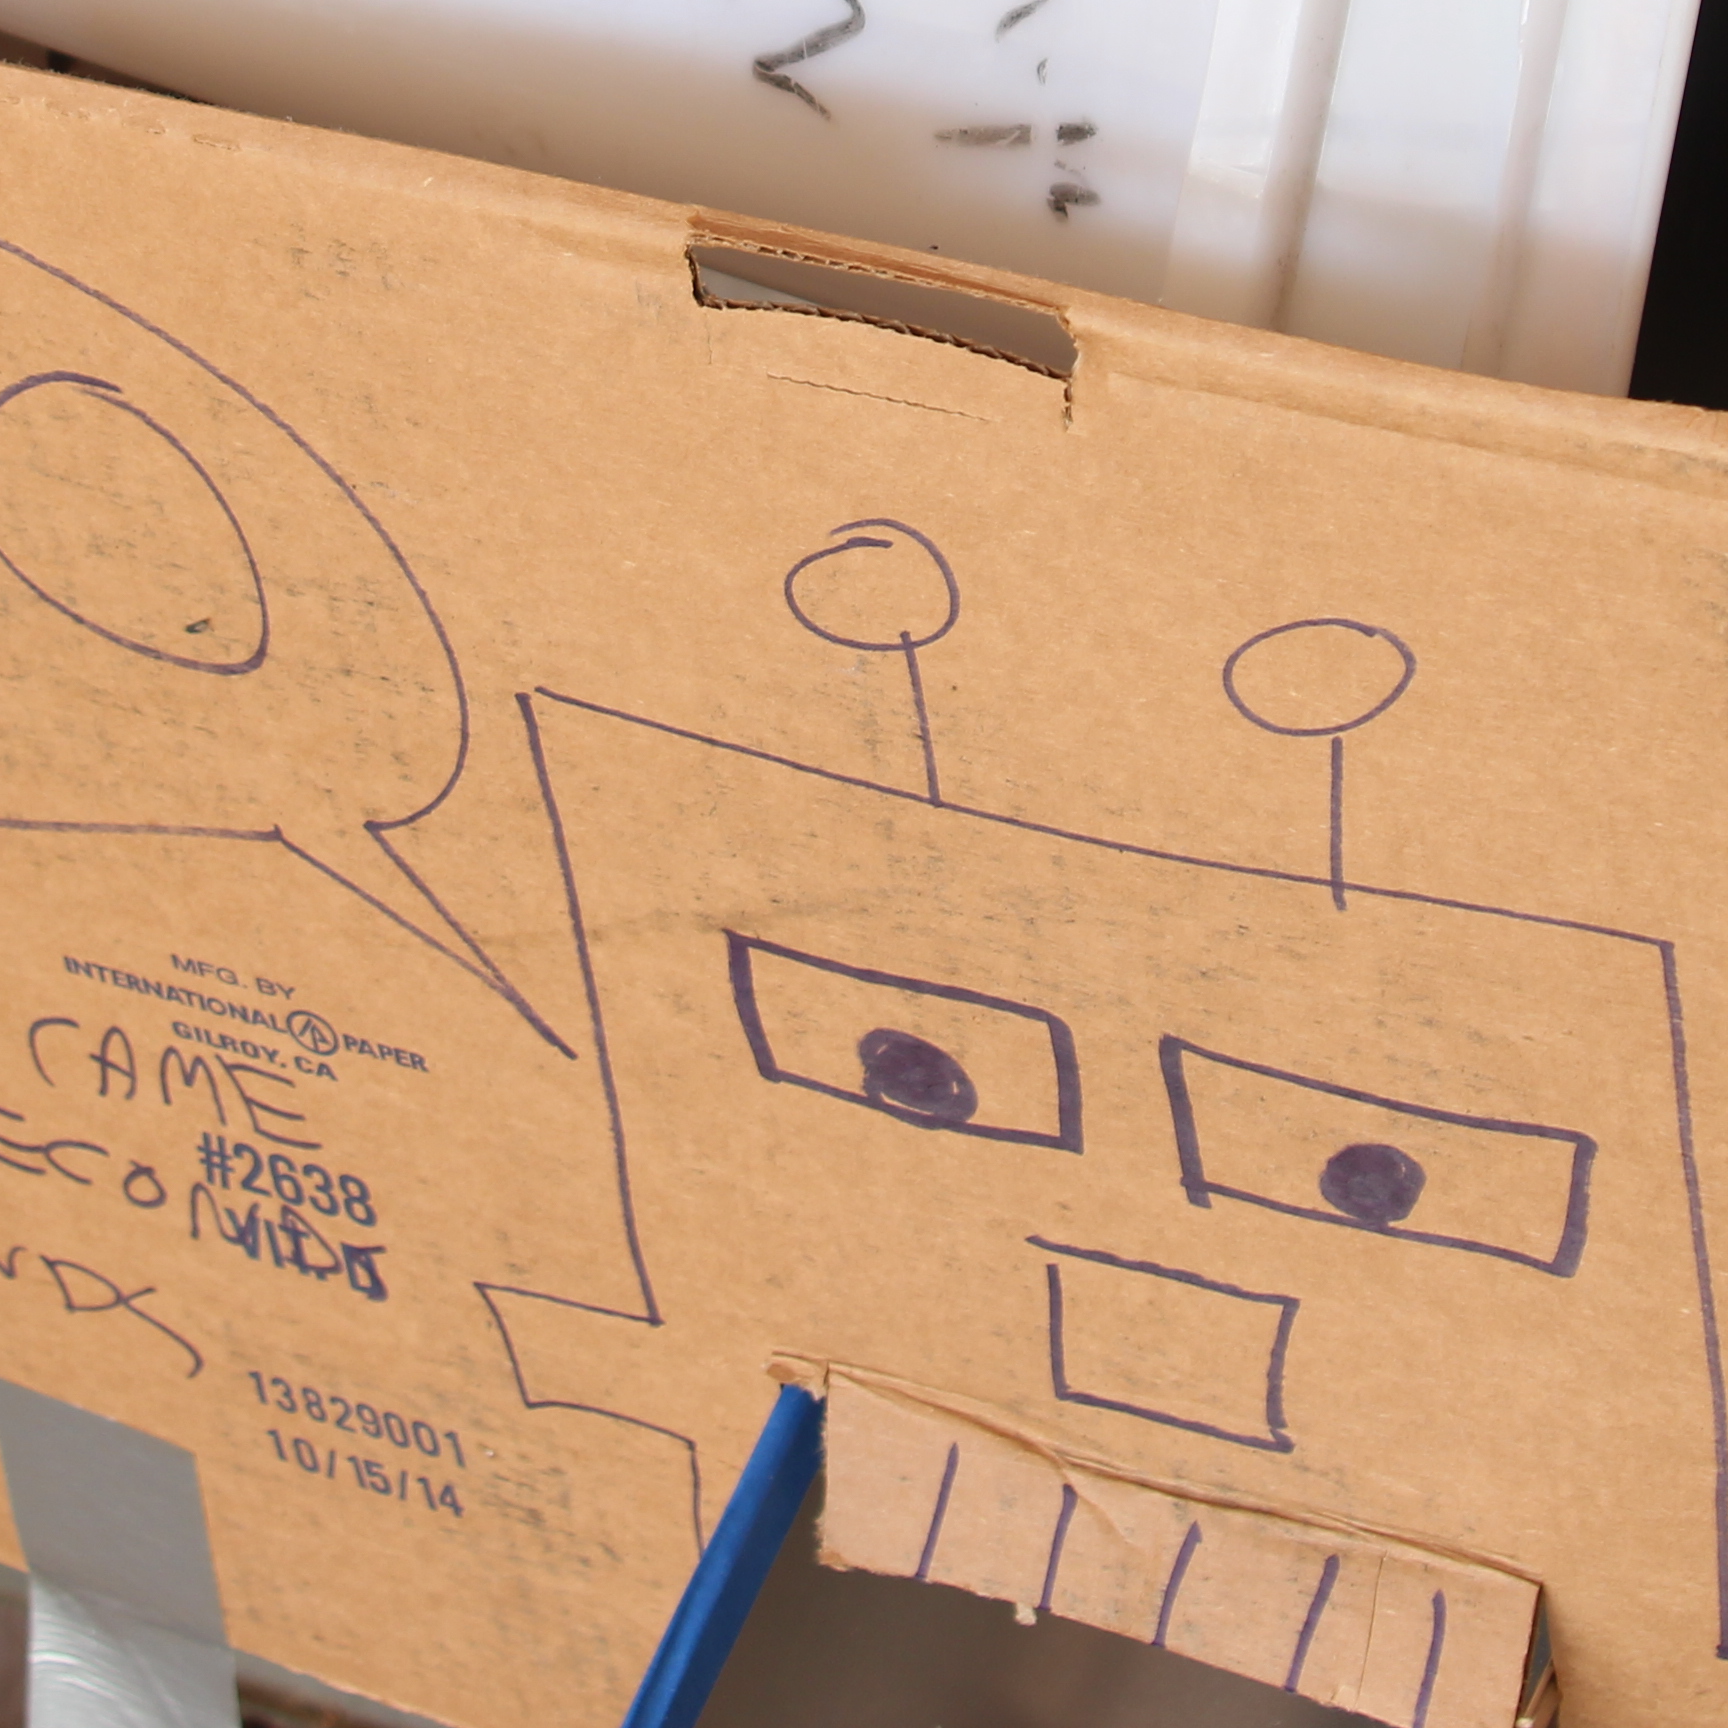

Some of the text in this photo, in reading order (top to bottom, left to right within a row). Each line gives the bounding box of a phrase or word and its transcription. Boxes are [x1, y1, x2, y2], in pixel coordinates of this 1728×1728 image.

[63, 954, 431, 1074] INTERNATIONAL PAPER
[170, 953, 297, 1001] MFG. BY
[28, 1016, 322, 1150] CAME
[294, 1055, 339, 1082] CA
[197, 1131, 378, 1228] #2638
[247, 1370, 467, 1469] 13829001
[266, 1428, 465, 1520] 10/15/14
